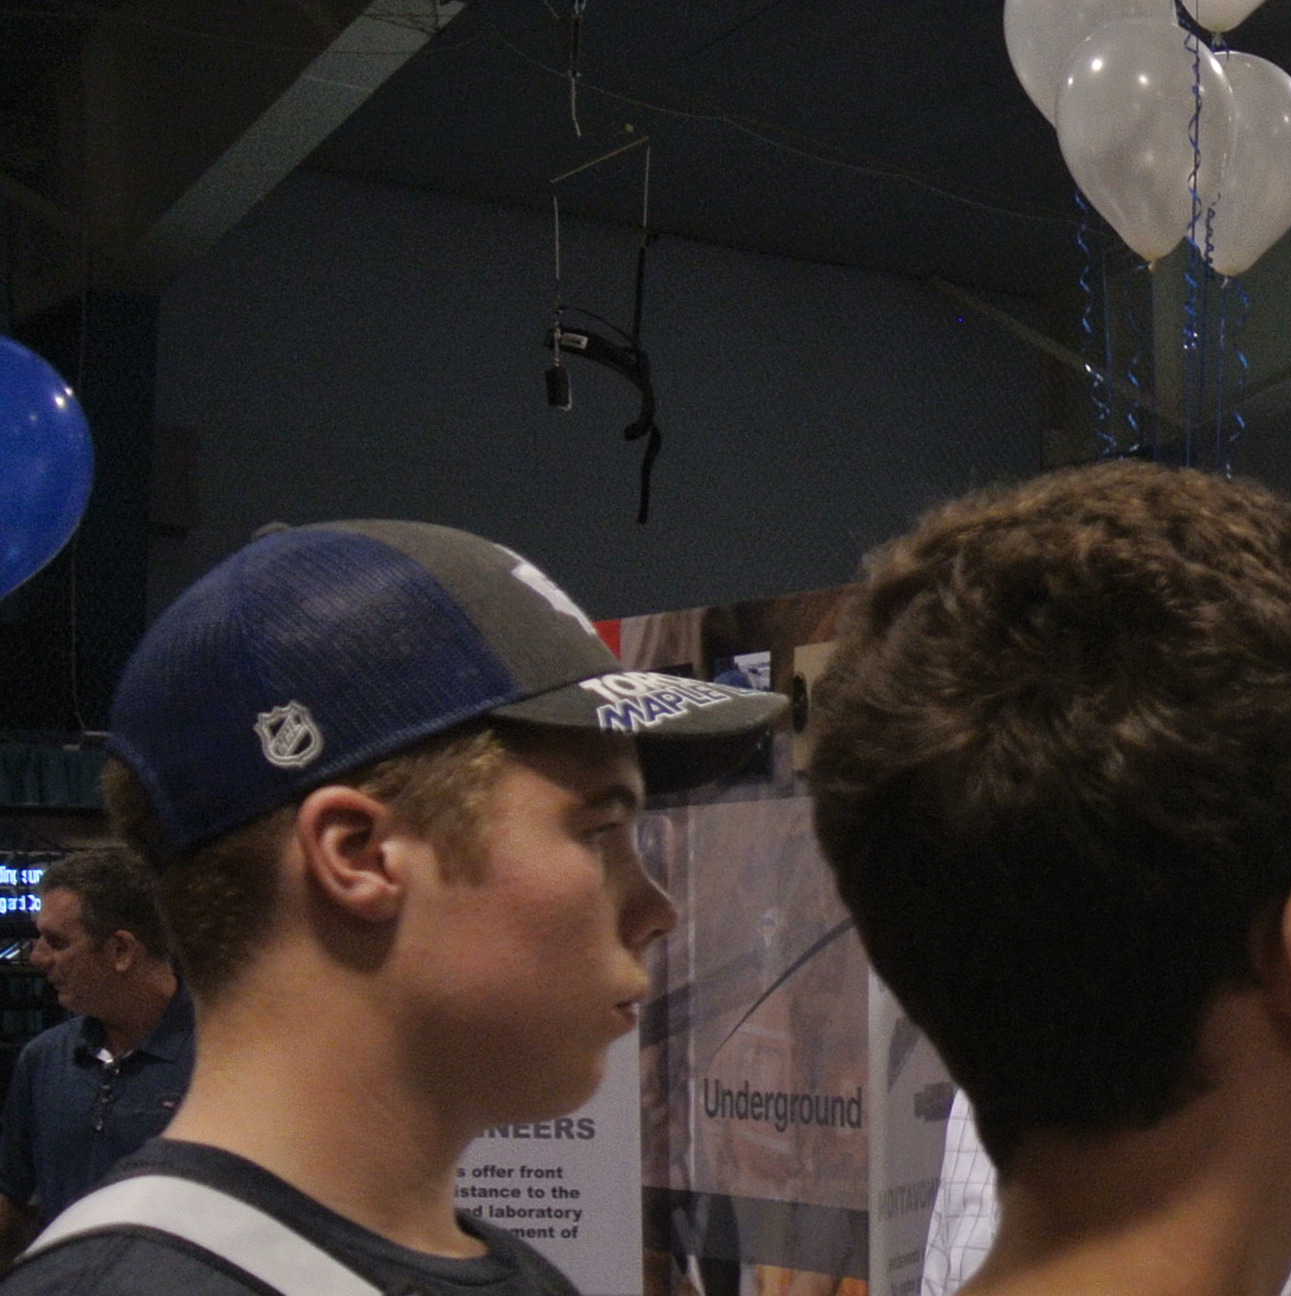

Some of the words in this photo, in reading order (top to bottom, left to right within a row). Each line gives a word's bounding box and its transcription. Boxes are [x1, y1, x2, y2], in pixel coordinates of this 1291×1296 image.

[597, 682, 732, 732] MAPLE
[703, 1078, 863, 1133] Underground
[471, 1165, 515, 1179] offer
[519, 1165, 564, 1179] front
[527, 1186, 546, 1199] to
[551, 1186, 581, 1200] the
[489, 1205, 583, 1223] laboratory
[560, 1226, 579, 1239] of
